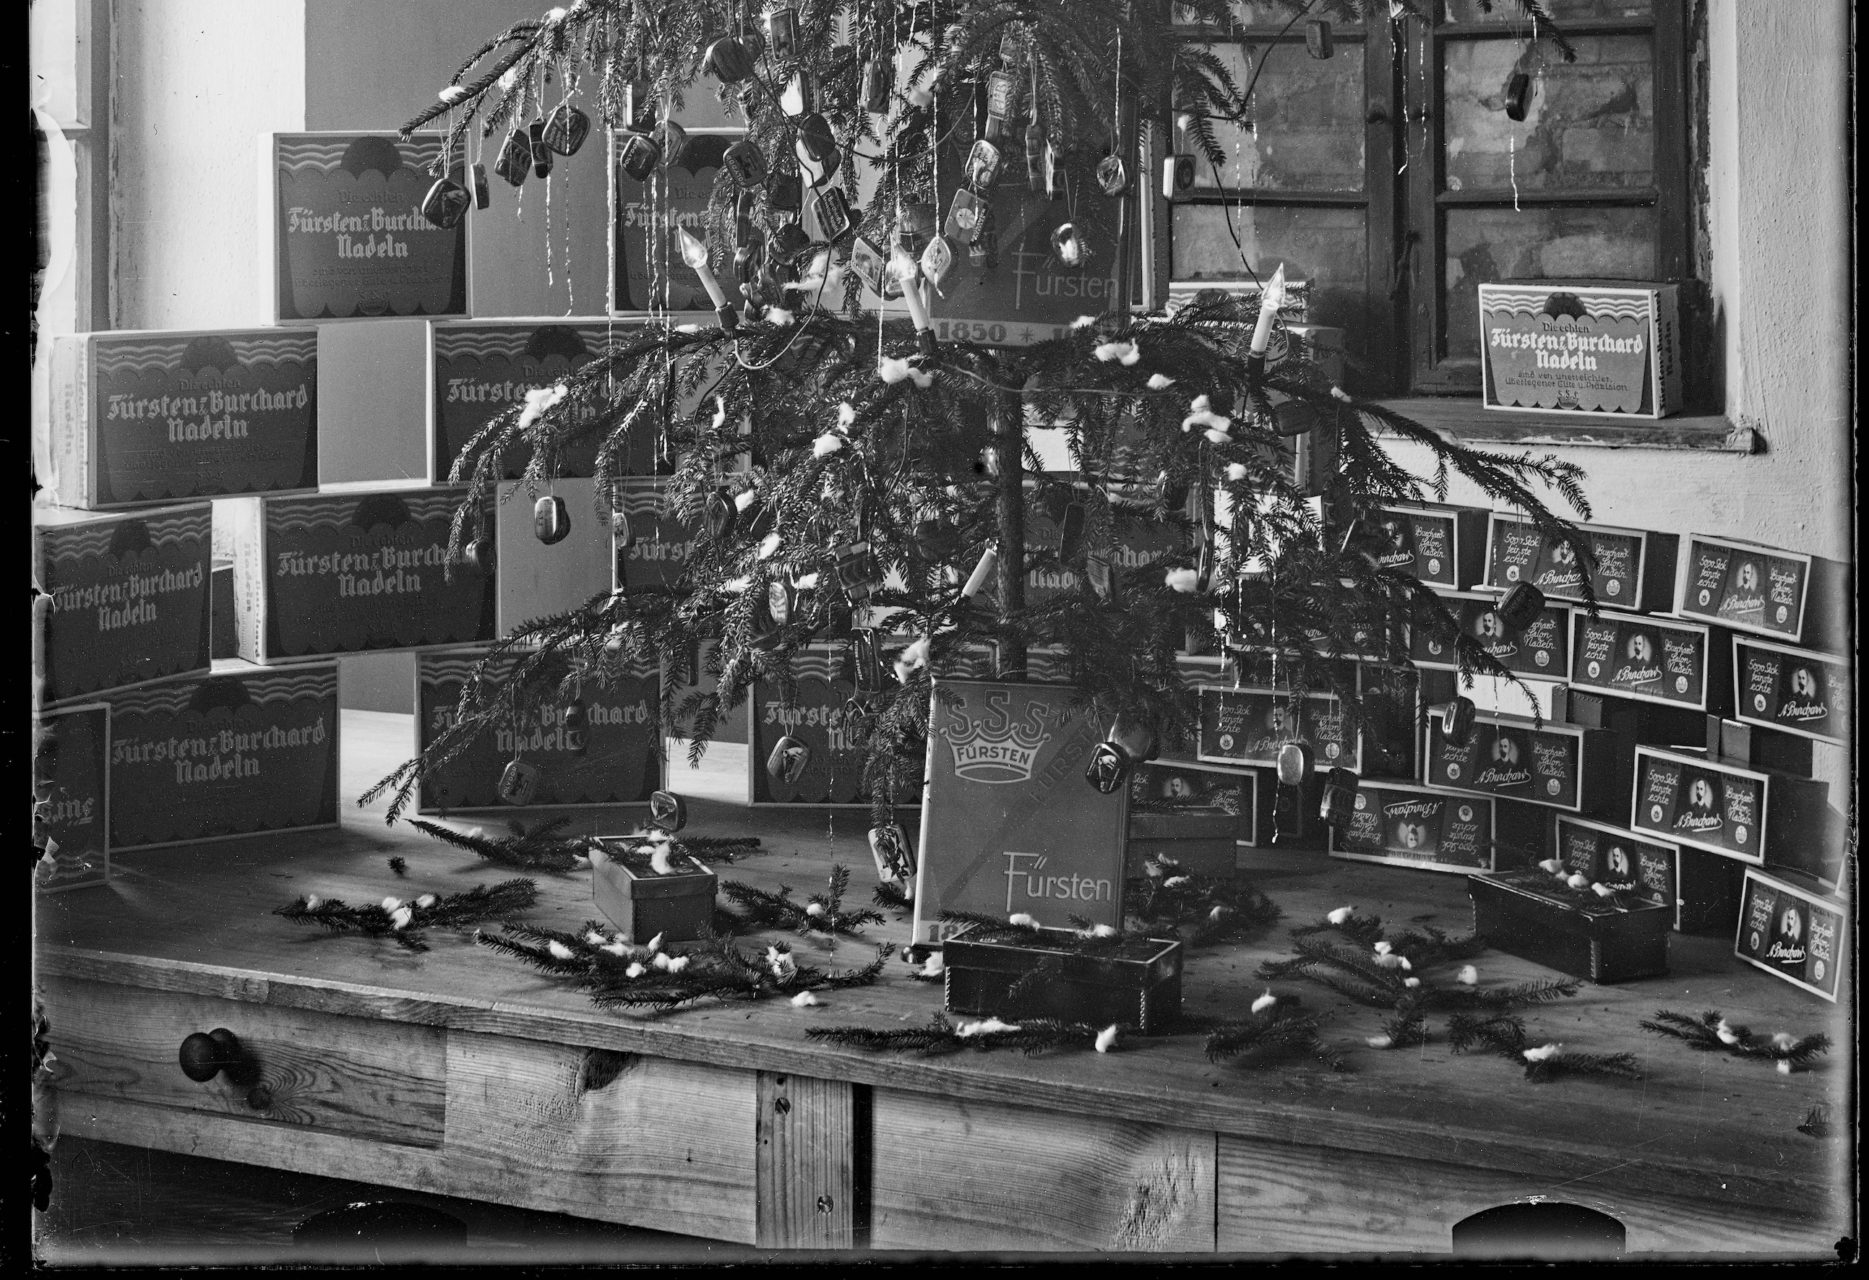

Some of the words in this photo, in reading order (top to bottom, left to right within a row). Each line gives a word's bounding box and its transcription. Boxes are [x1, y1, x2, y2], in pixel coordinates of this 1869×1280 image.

[336, 233, 409, 259] Nadeln
[938, 322, 1007, 342] 1850
[1566, 331, 1644, 354] Burchard
[1535, 349, 1598, 371] Nadeln
[208, 383, 308, 415] Burchard
[166, 414, 249, 443] Nadeln
[128, 561, 203, 600] Burchard
[338, 569, 422, 598] Nadeln
[98, 599, 158, 632] Nadeln
[218, 716, 326, 756] Burchard
[495, 723, 571, 752] Nadel
[174, 754, 261, 784] Nadeln
[956, 744, 1031, 766] FÜRSTEN
[1002, 851, 1112, 913] Fürsten
